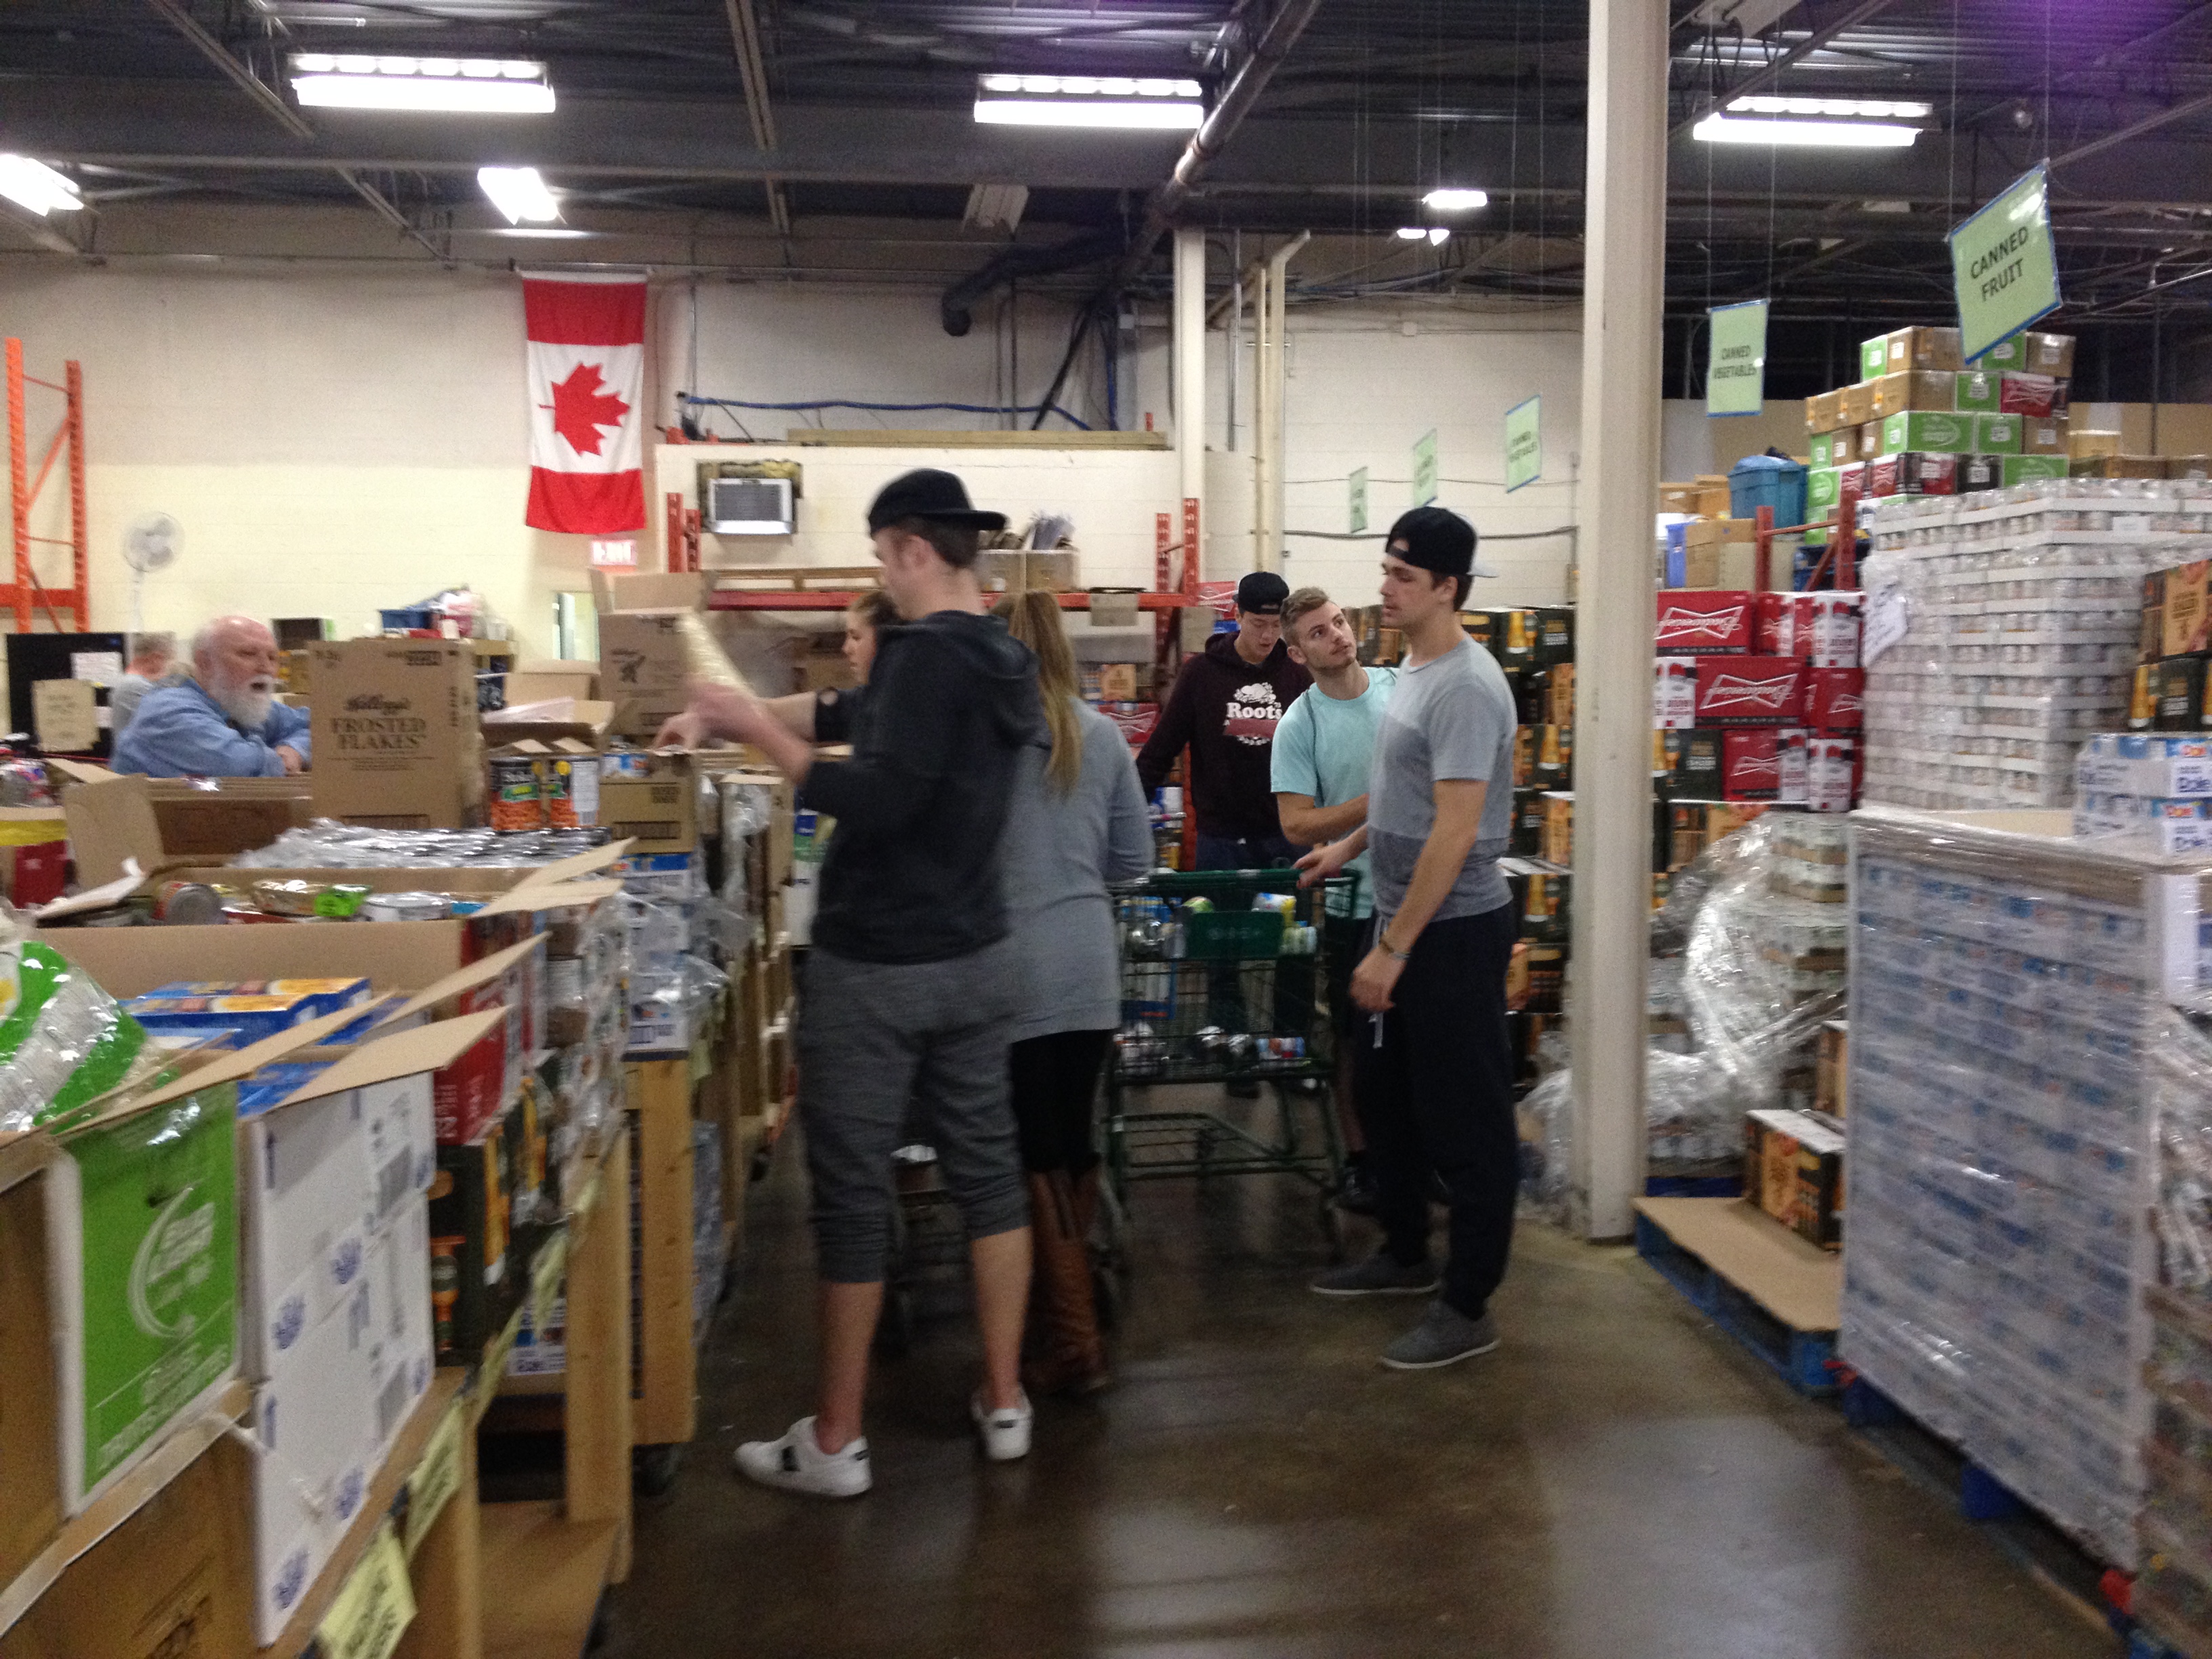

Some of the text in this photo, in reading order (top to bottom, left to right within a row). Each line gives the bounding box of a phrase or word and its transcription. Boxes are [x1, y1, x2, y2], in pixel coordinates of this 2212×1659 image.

[1970, 226, 2029, 279] CANNED
[1981, 258, 2024, 302] FRUIT
[1226, 702, 1282, 720] Roots
[331, 717, 426, 734] FROSTED
[338, 734, 421, 750] FLAKES
